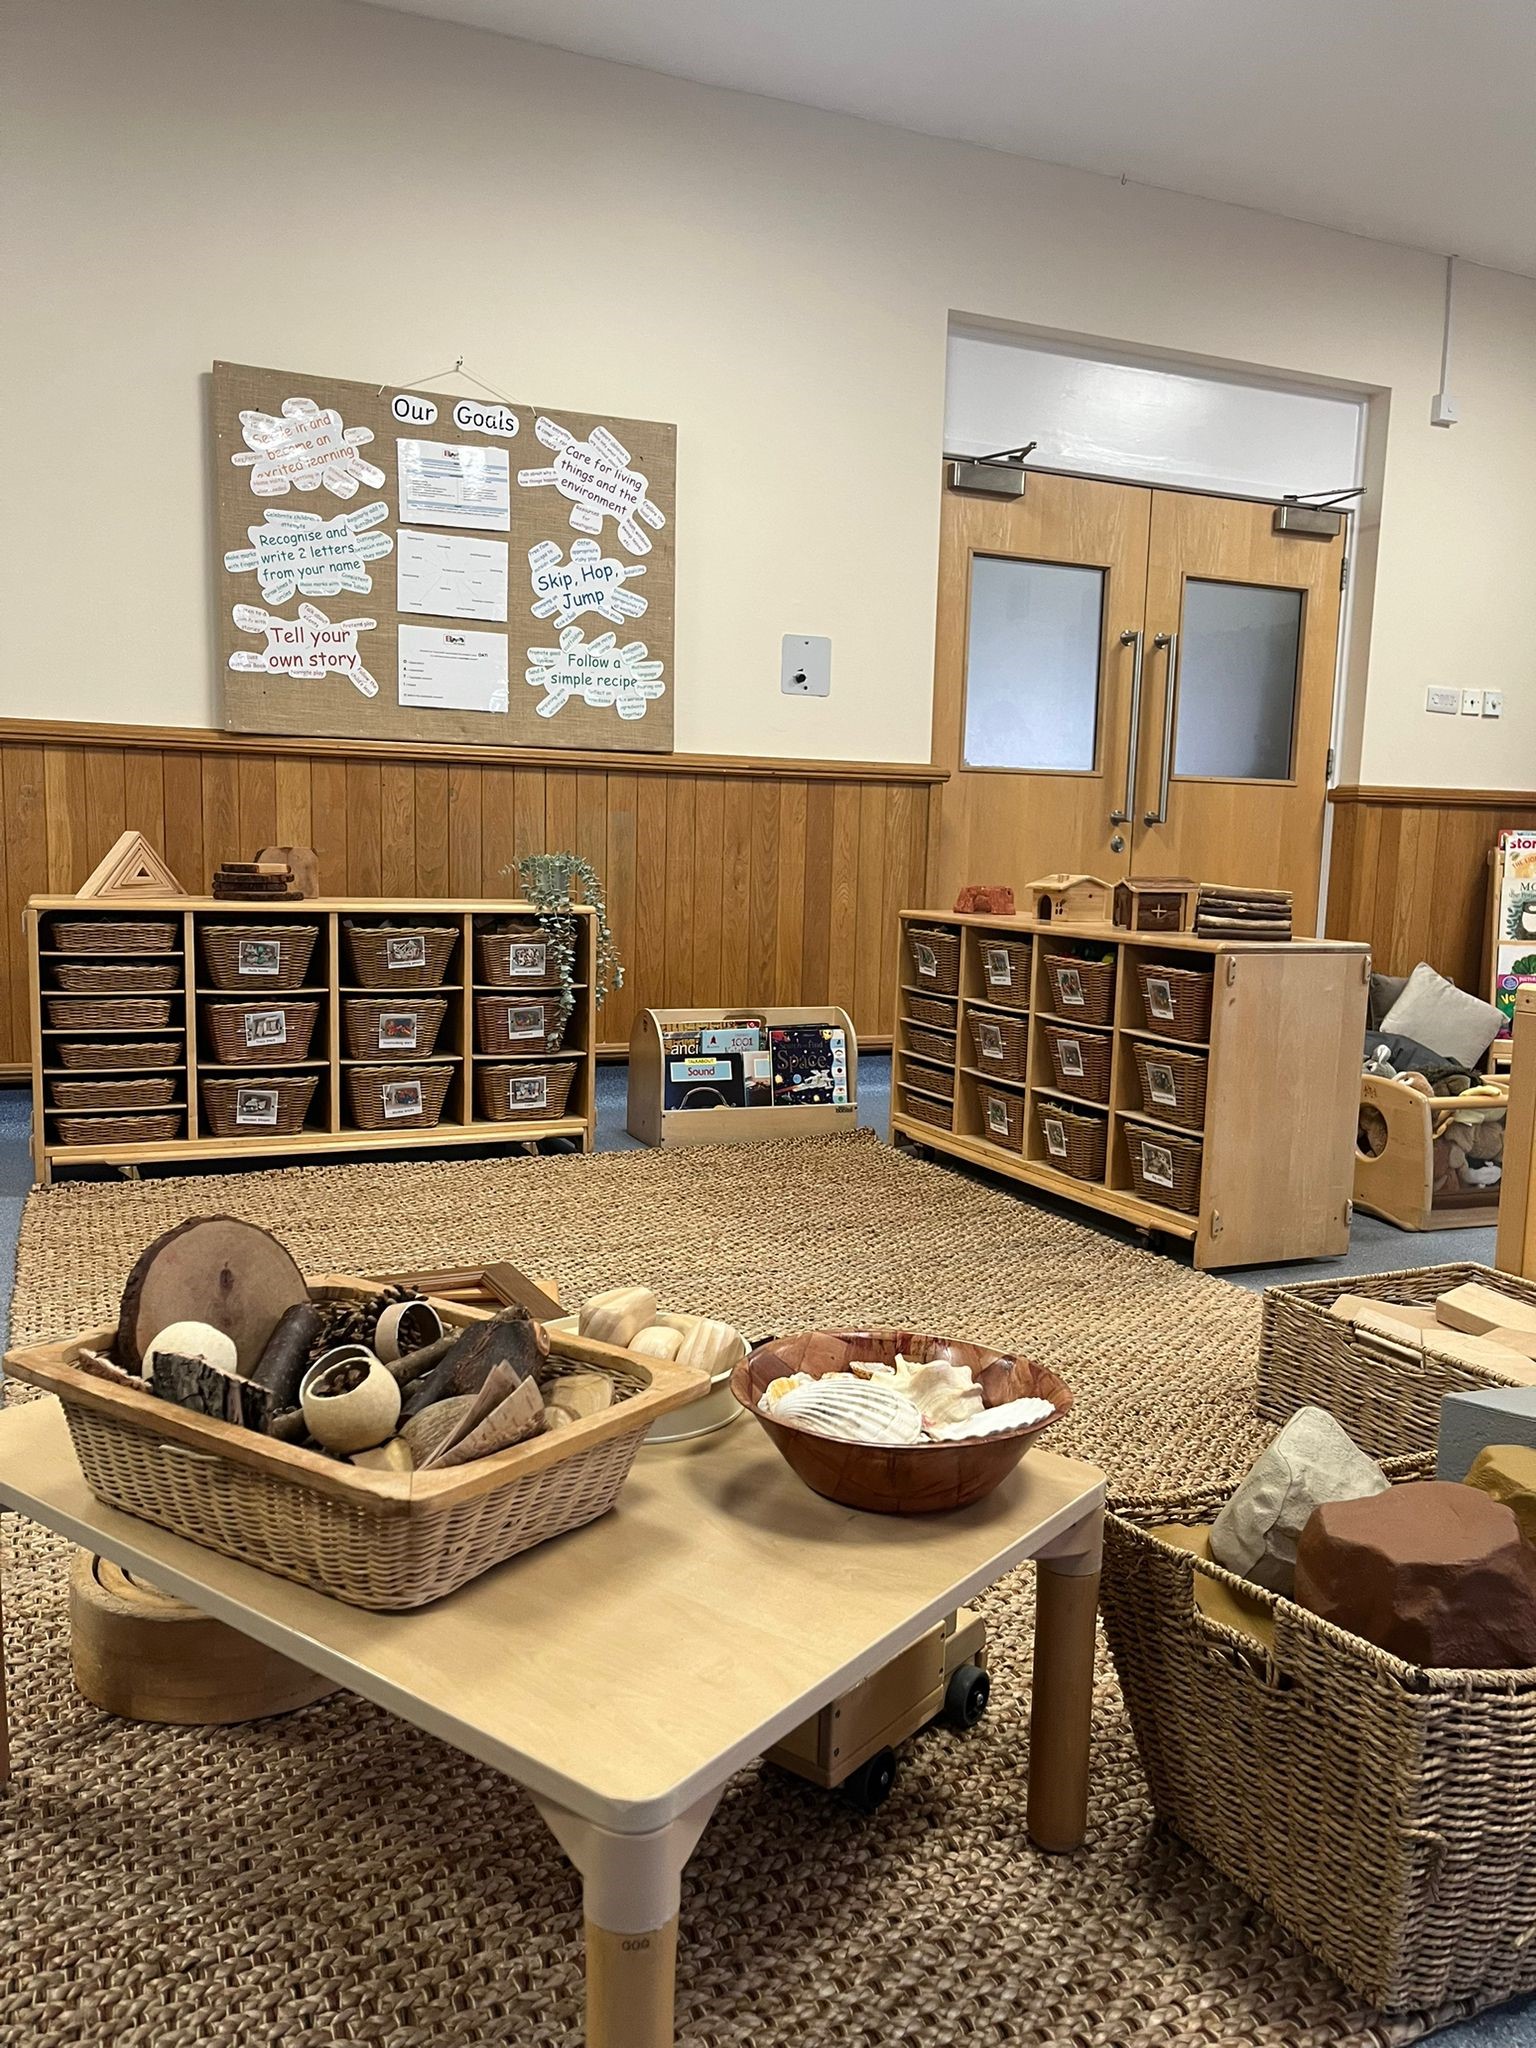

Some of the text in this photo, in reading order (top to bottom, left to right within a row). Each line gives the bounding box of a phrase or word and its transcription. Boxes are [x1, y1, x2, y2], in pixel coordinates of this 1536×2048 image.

[394, 398, 514, 432] Our Goals
[252, 426, 294, 444] Sele
[295, 423, 307, 434] in
[309, 412, 332, 429] and
[316, 434, 331, 447] an
[565, 445, 643, 492] Care for living
[561, 460, 638, 504] things and the
[561, 477, 628, 516] environment
[259, 524, 348, 547] Recognise and
[260, 543, 355, 564] write 2 letters
[263, 560, 361, 582] from your name
[538, 565, 619, 591] Skip, Hop,
[563, 590, 605, 609] Jump
[270, 626, 350, 648] Tell your
[269, 654, 304, 667] own
[309, 652, 357, 670] story
[568, 653, 621, 669] Follow a
[550, 672, 638, 690] simple recipe
[731, 1037, 753, 1047] 1001
[687, 1066, 715, 1077] Sound
[777, 1050, 827, 1073] Space
